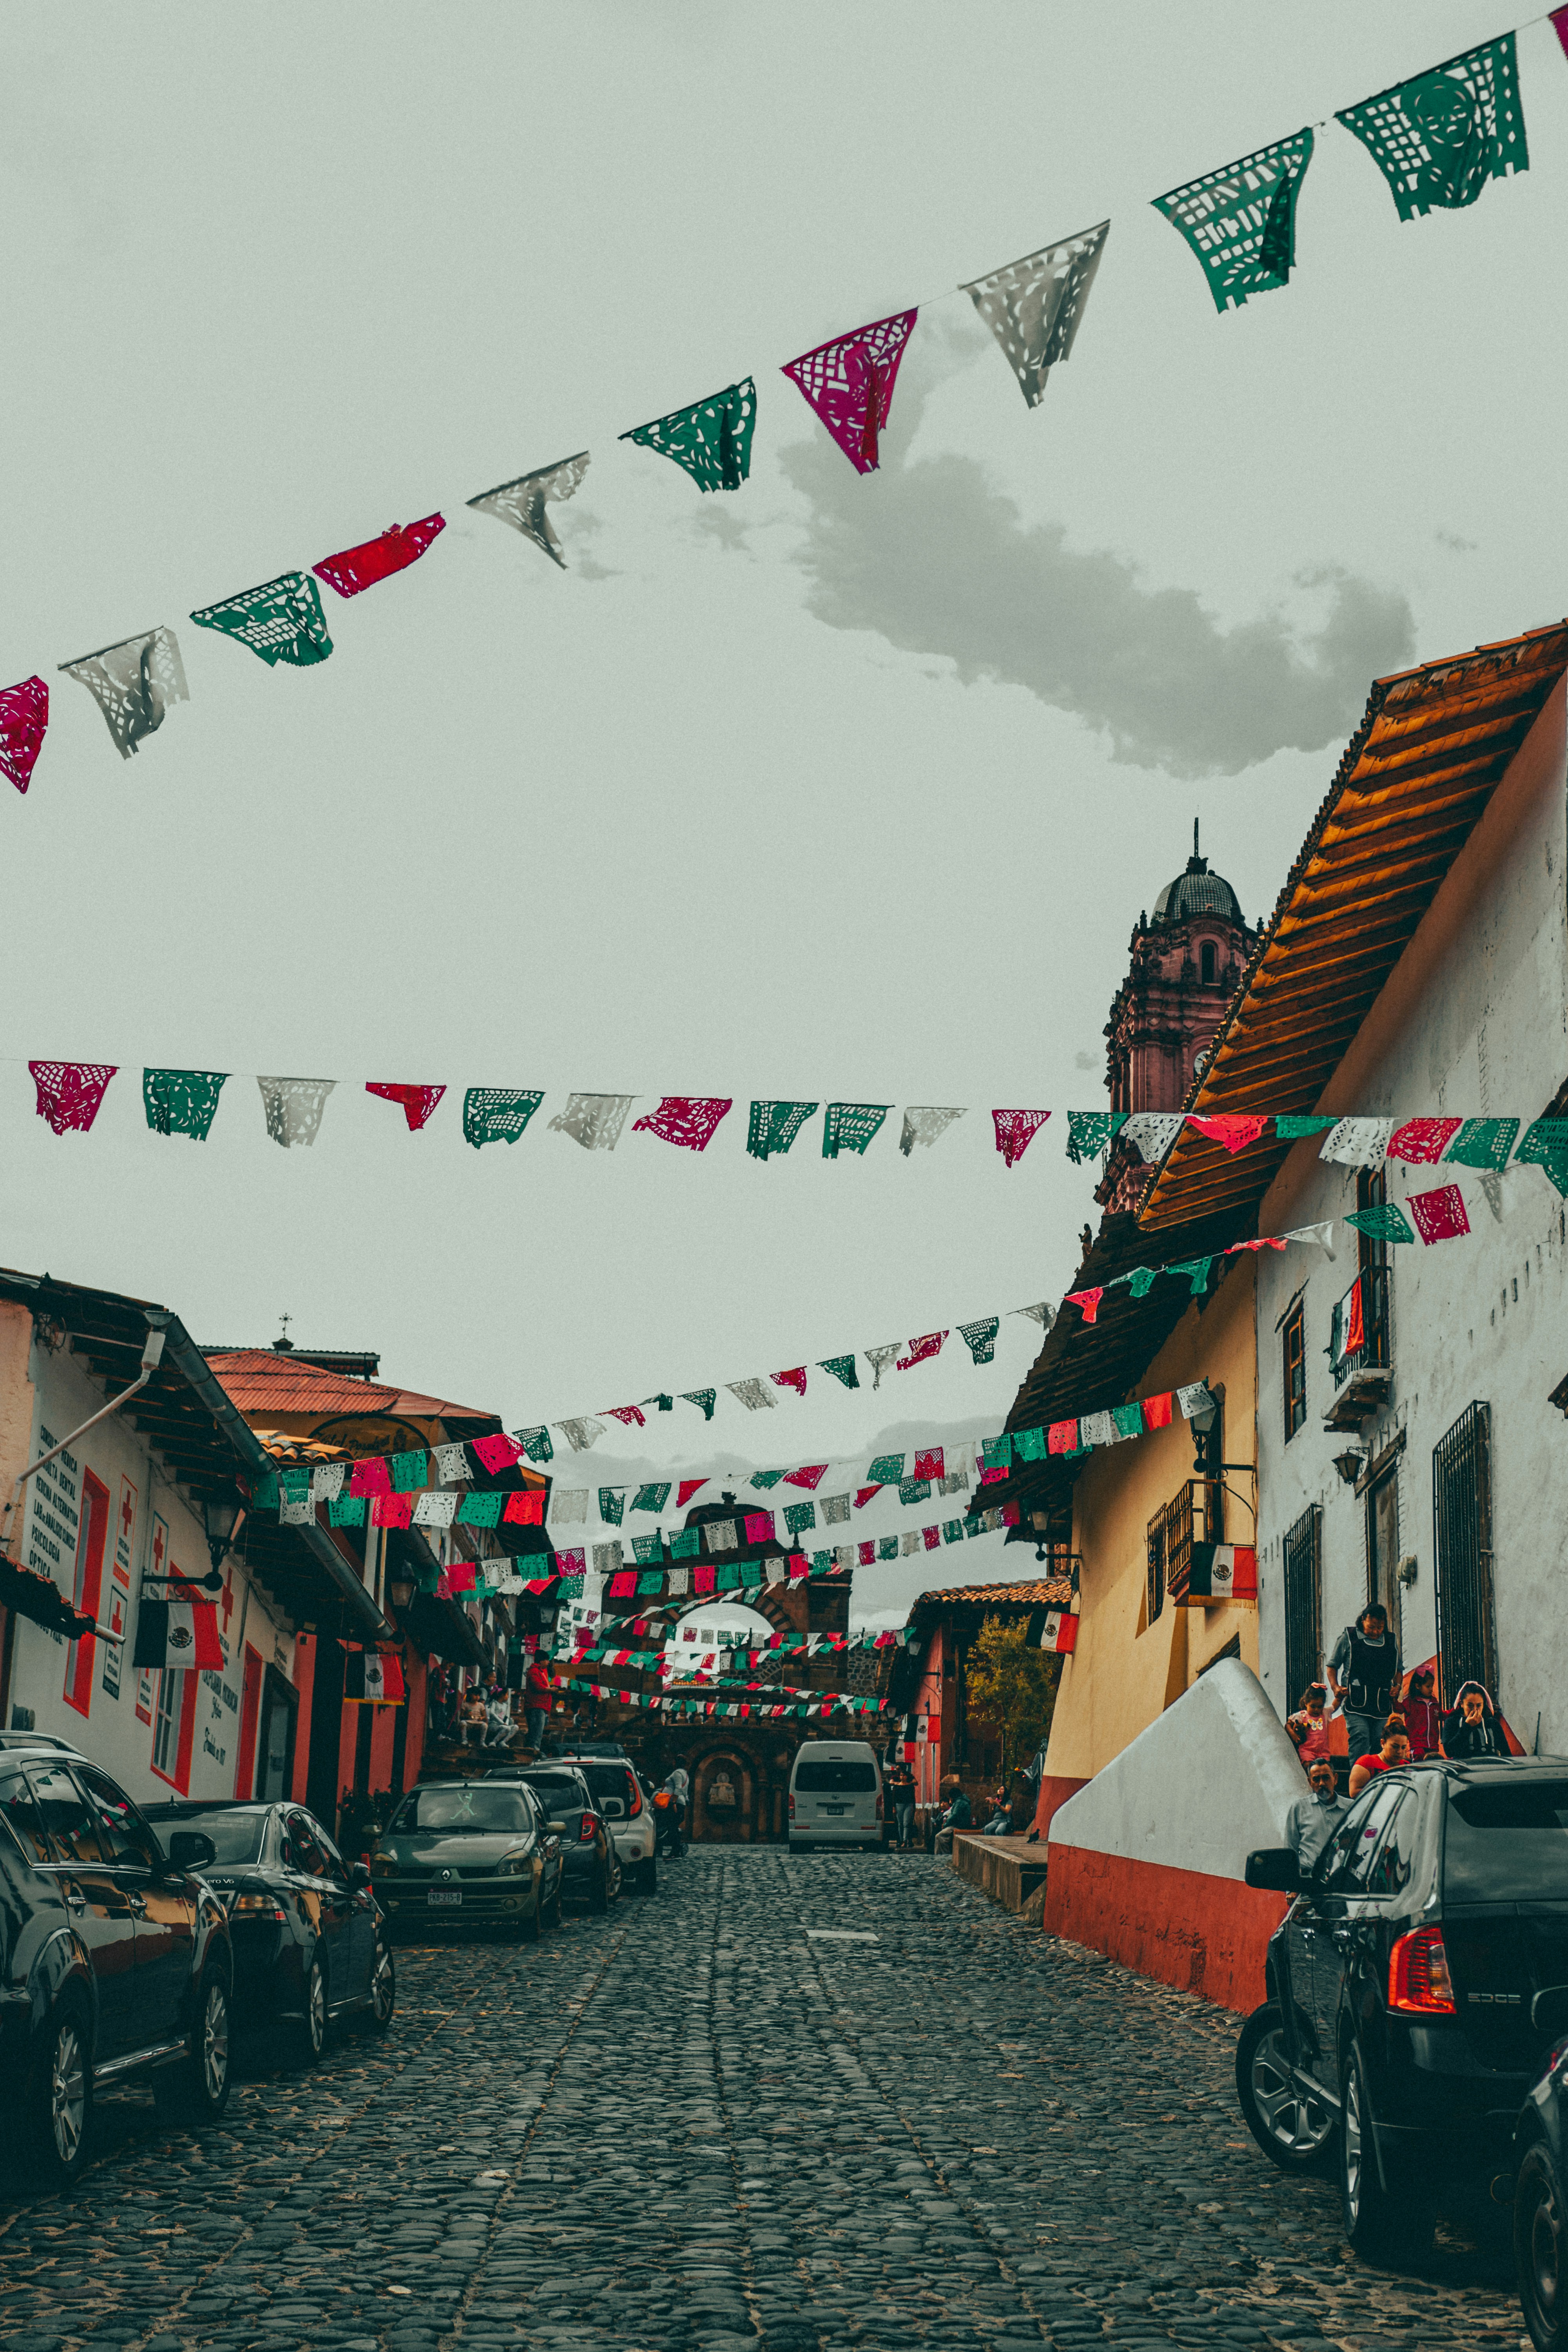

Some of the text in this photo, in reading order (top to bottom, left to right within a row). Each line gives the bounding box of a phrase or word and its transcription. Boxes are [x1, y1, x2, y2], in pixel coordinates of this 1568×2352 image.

[60, 1472, 76, 1501] DENTAL
[32, 1524, 60, 1564] PSICOLOGÍA
[29, 1544, 50, 1579] ÓPTICA
[1468, 1993, 1521, 2004] EDGE
